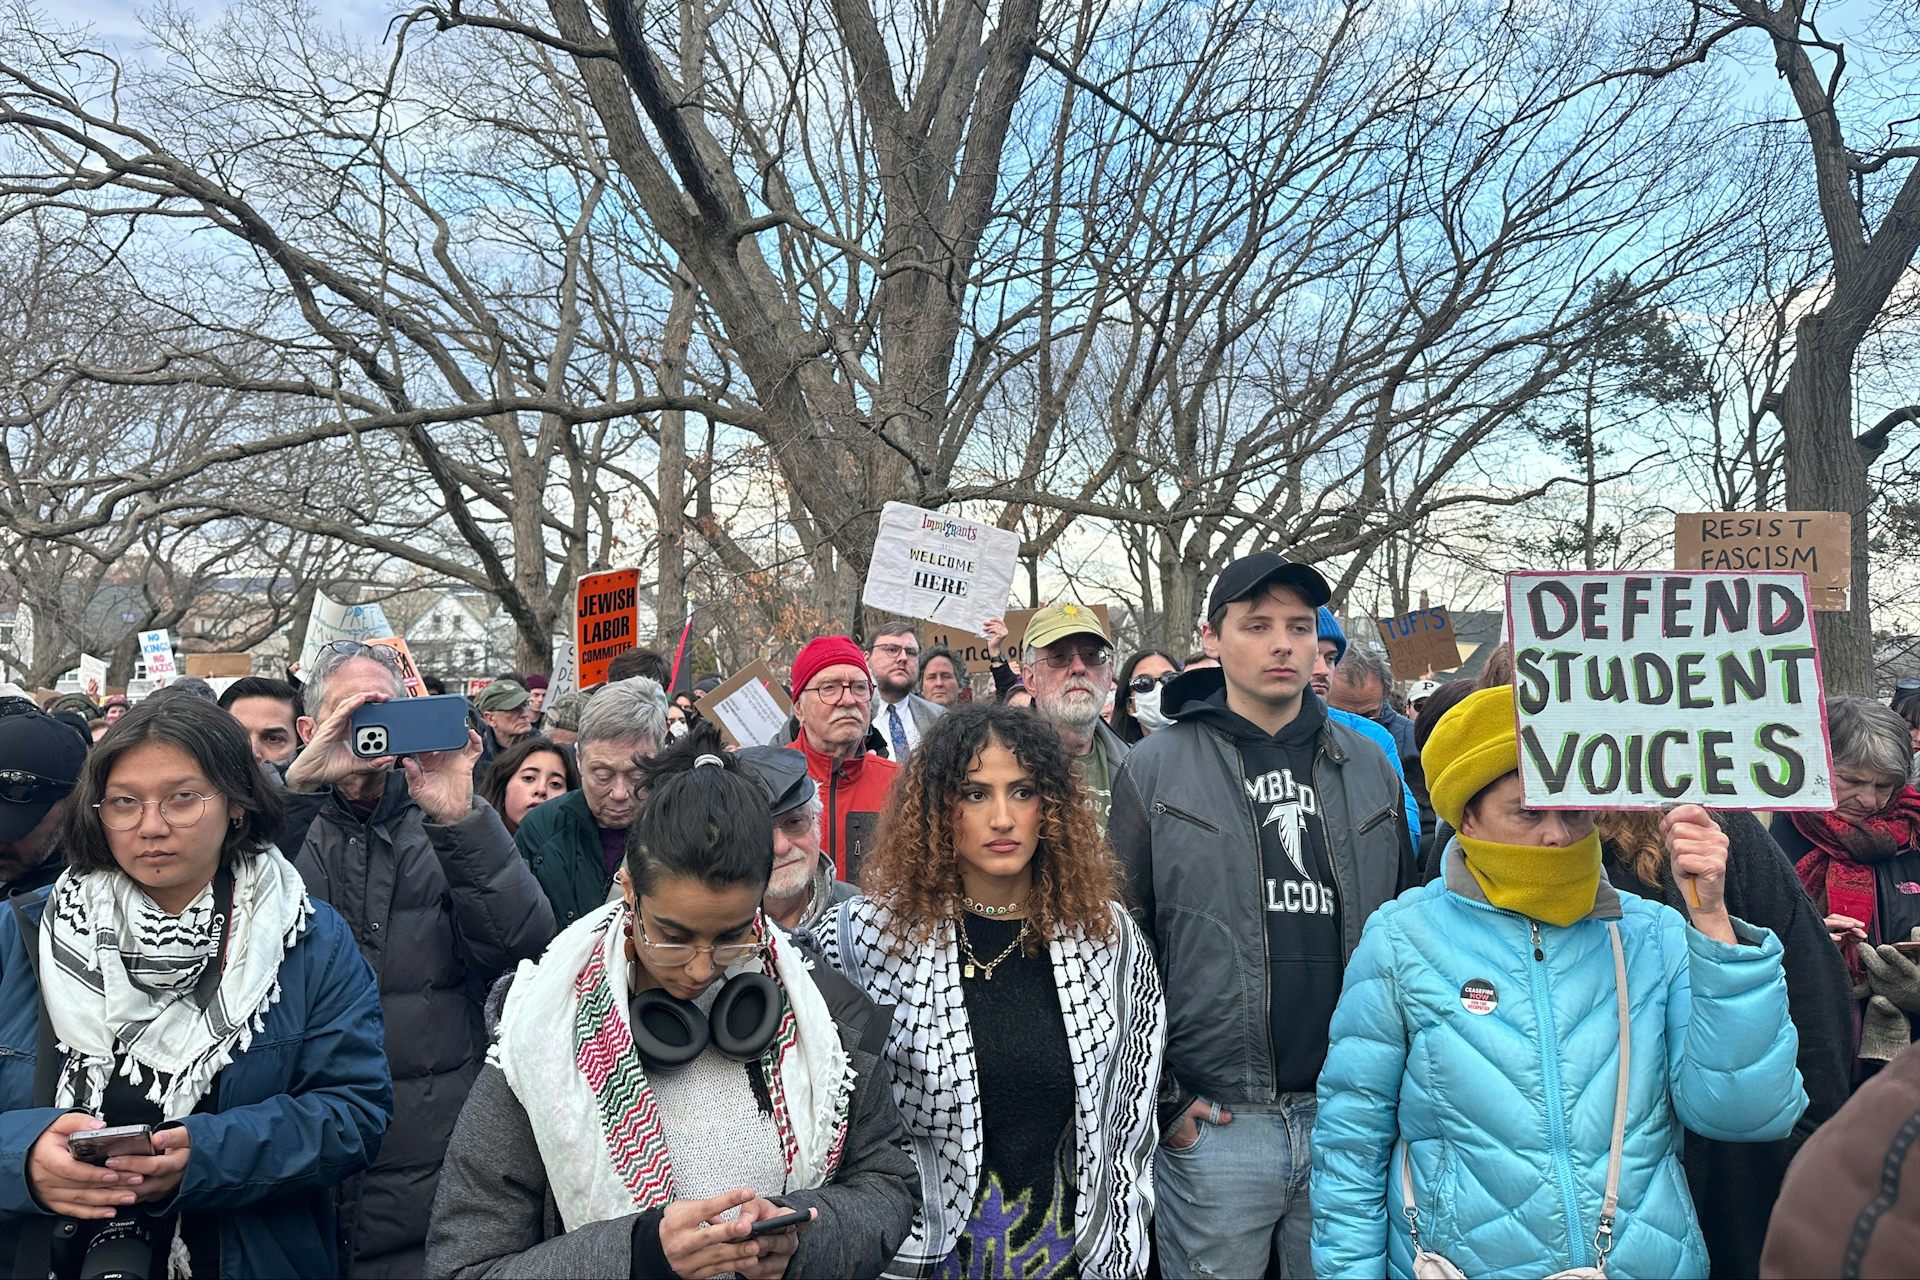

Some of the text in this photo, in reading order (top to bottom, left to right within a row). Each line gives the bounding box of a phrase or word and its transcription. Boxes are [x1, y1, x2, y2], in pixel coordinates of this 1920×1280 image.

[1701, 518, 1812, 542] RESIST
[910, 548, 975, 573] WELCOME
[1701, 546, 1818, 572] FASCISM
[914, 571, 968, 597] HERE
[579, 586, 636, 618] JEWISH
[1526, 577, 1805, 642] DEFEND
[583, 615, 630, 645] LABOR
[1382, 606, 1446, 639] TUFTS
[143, 642, 170, 653] KINGS
[147, 633, 160, 642] NO
[147, 662, 175, 674] NAZIS
[153, 654, 165, 663] NO
[1516, 644, 1816, 716] STUDENT
[1520, 721, 1805, 798] VOICES
[209, 913, 225, 958] Canon
[1470, 992, 1489, 1000] NOW
